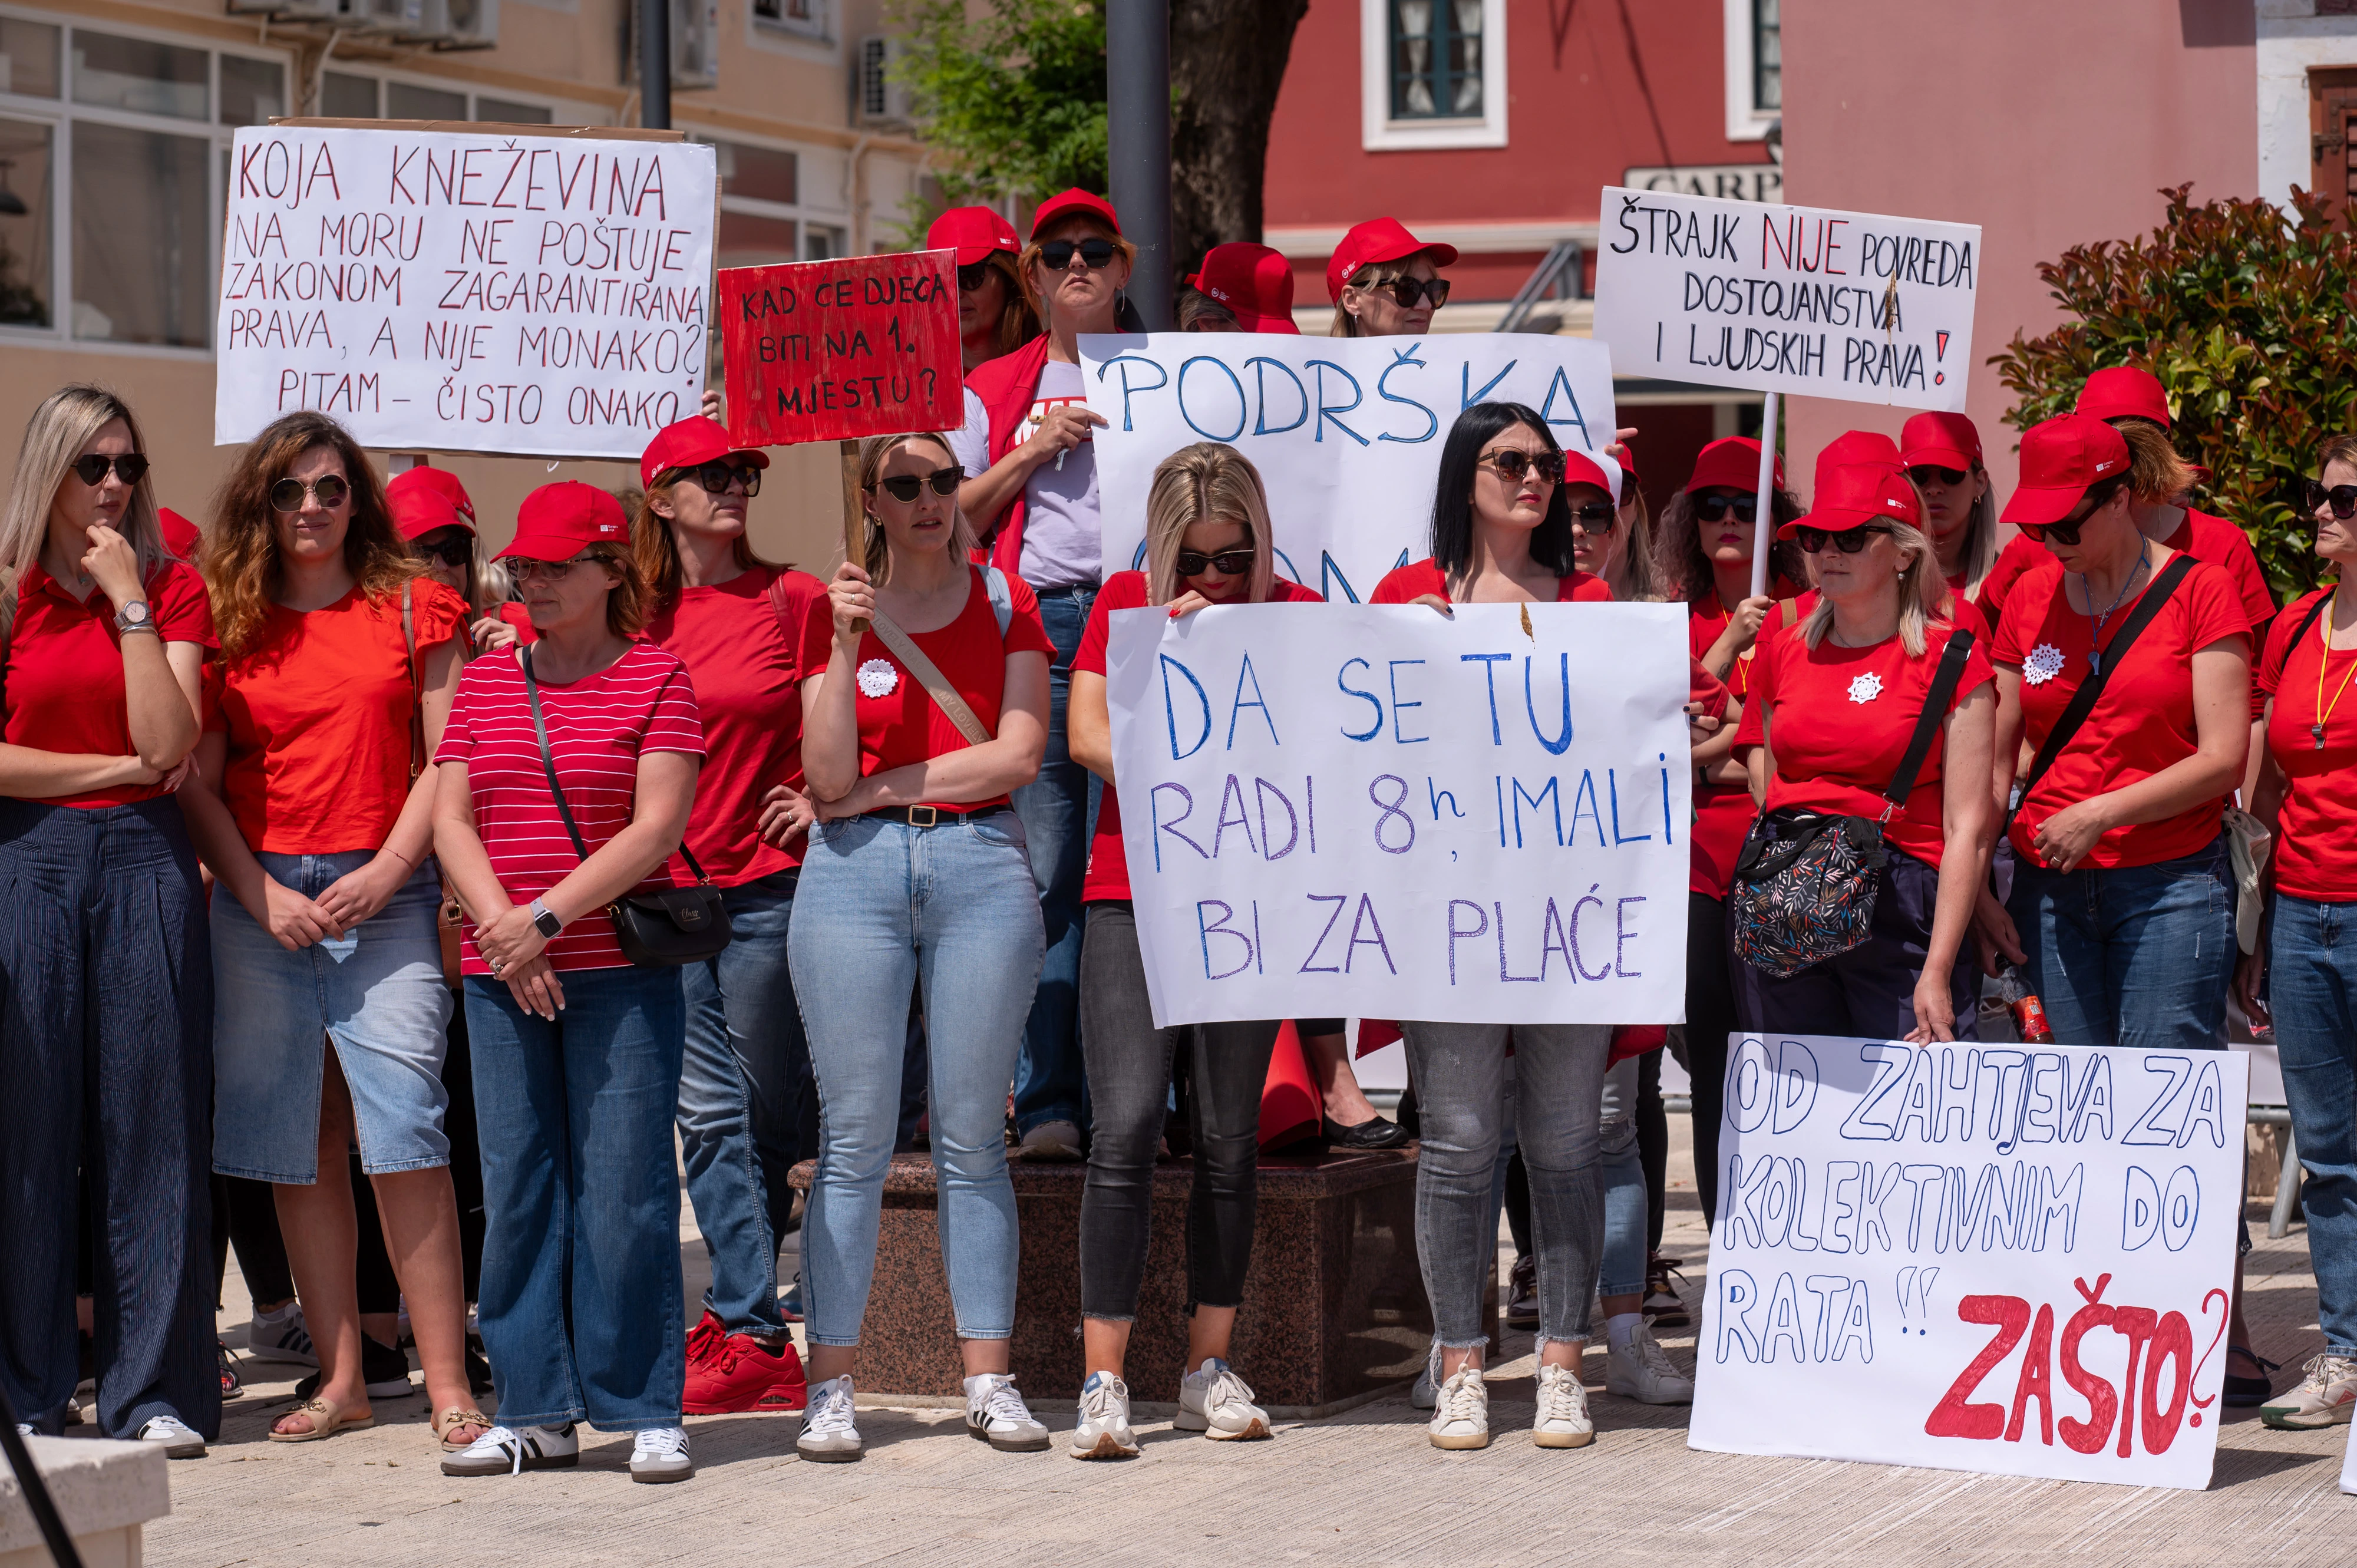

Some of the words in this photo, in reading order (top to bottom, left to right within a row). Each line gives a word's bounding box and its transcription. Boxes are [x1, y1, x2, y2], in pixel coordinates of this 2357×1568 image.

[240, 140, 340, 209] KOJA
[391, 138, 665, 220] KNEŽEVINA
[236, 212, 288, 258] NA
[319, 213, 423, 261] MORU
[461, 219, 514, 265] NE
[537, 217, 691, 283] POŠTUJE
[1610, 196, 1739, 262] ŠTRAJK
[1762, 213, 1849, 275] NIJE
[1861, 233, 1972, 290] POVREDA
[226, 262, 401, 306] ZAKONOM
[438, 272, 703, 325] ZAGARANTIRANA
[742, 286, 796, 322] KAD
[864, 273, 948, 305] DJECA
[1684, 272, 1903, 332] DOSTOJANSTVA
[230, 309, 346, 359] PRAVA,
[369, 317, 397, 359] A
[425, 321, 493, 372] NIJE
[519, 324, 701, 387] MONAKO?
[760, 334, 809, 362] BITI
[825, 330, 872, 359] NA
[888, 316, 915, 352] 1.
[1657, 322, 1662, 362] I
[1689, 323, 1825, 377] LJUDSKIH
[1844, 329, 1950, 391] PRAVA!
[279, 369, 379, 412] PITAM
[437, 377, 542, 424] ČISTO
[568, 386, 678, 430] ONAKO
[1160, 650, 1280, 760] DA
[1338, 658, 1429, 744] SE
[1461, 653, 1573, 755] TU
[1151, 774, 1315, 873] RADI
[1197, 900, 1263, 980] BI
[1297, 893, 1397, 975] ZA
[1448, 883, 1646, 985] PLAĆE
[1727, 1039, 1818, 1134] OD
[1840, 1043, 2114, 1156] ZAHTJEVA
[2120, 1055, 2224, 1148] ZA
[1724, 1154, 2083, 1255] KOLEKTIVNIM
[2122, 1165, 2200, 1252] DO
[1716, 1269, 1873, 1364] RATA
[1924, 1273, 2229, 1458] ZAŠTO?
